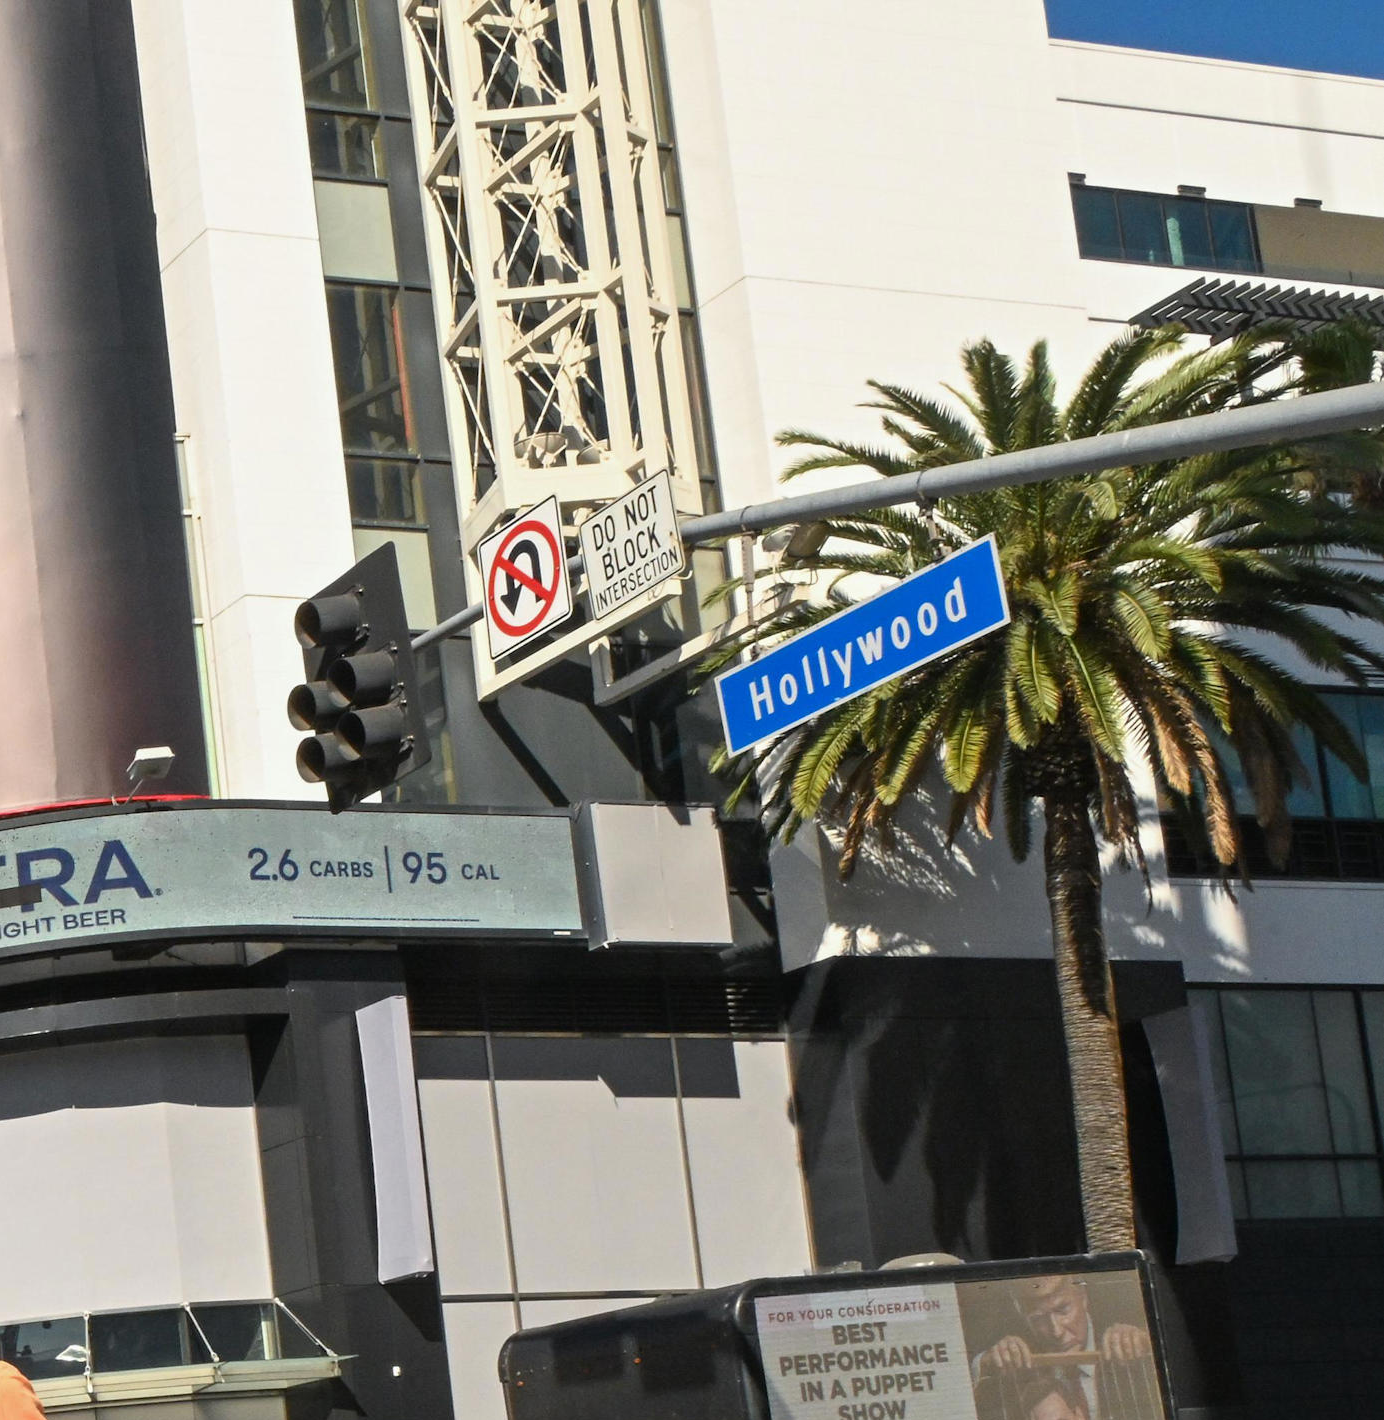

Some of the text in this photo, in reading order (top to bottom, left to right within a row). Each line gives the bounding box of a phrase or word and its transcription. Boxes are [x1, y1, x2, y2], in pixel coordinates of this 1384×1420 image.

[592, 485, 659, 551] DO NOT
[602, 522, 661, 581] BLOCK
[595, 546, 679, 613] INTERSECTION
[749, 576, 967, 721] Hollywood
[248, 848, 500, 884] 2.6 CARBS 95 CAL
[63, 909, 126, 930] BEER
[768, 1300, 940, 1323] FOR YOUR CONSIDERATION
[832, 1322, 887, 1345] BEST
[779, 1343, 949, 1376] PERFORMANCE
[800, 1371, 936, 1401] IN A PUPPET
